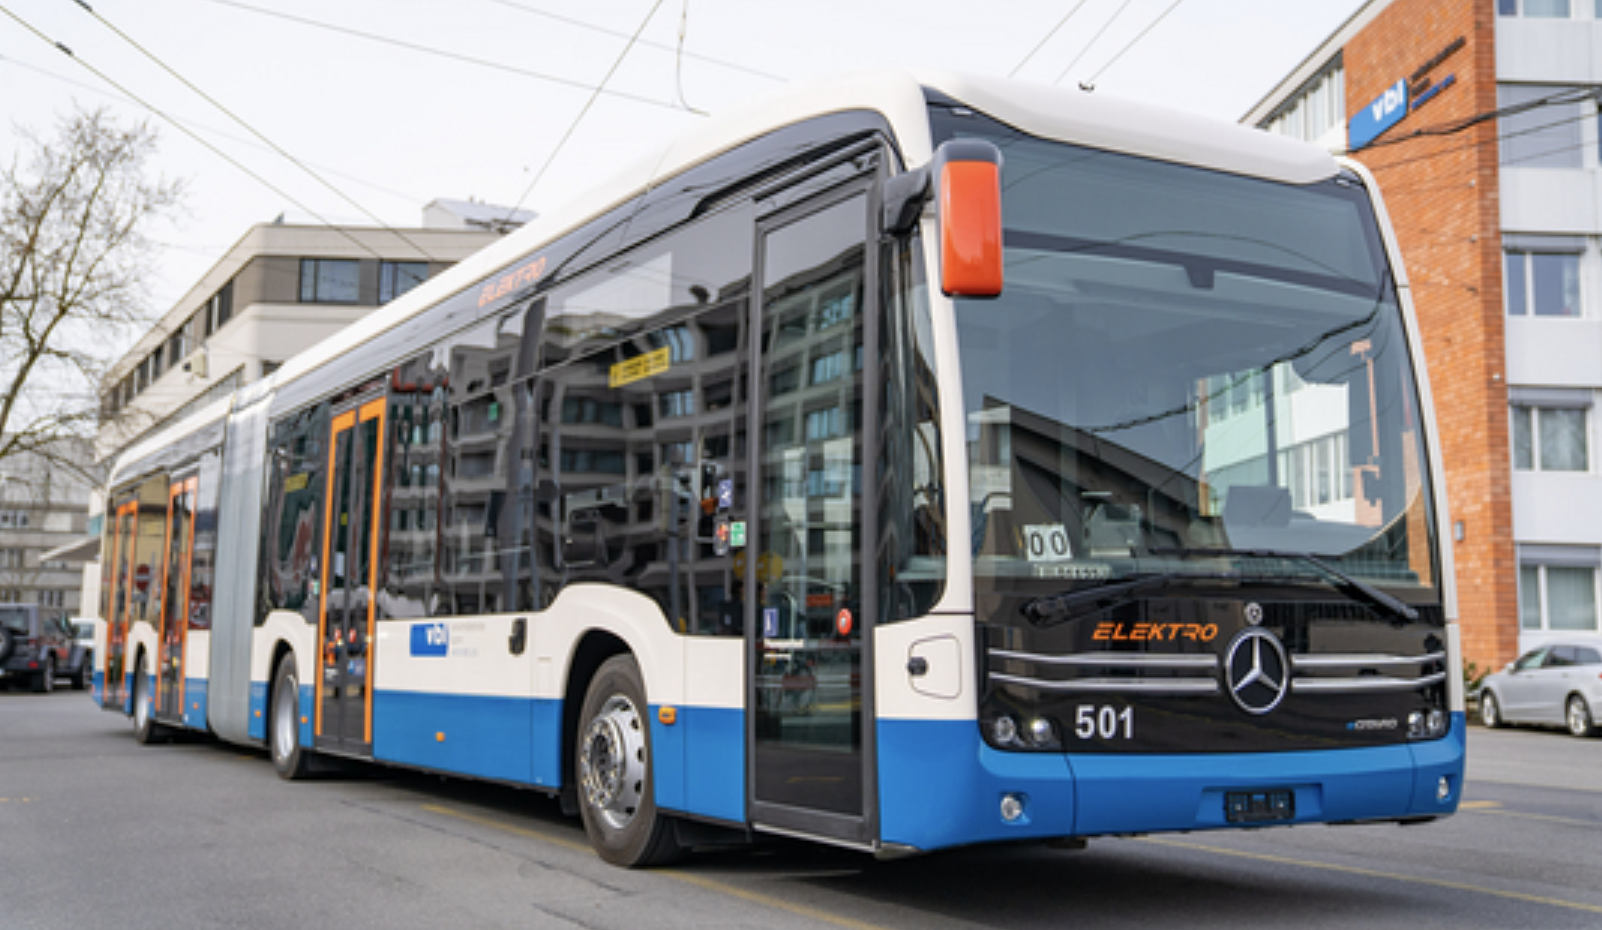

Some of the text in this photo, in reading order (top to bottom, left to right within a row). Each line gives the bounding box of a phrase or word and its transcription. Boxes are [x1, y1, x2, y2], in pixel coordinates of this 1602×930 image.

[1373, 79, 1403, 121] vbl
[1092, 622, 1219, 641] ELEKTRO
[1075, 704, 1134, 739] 501
